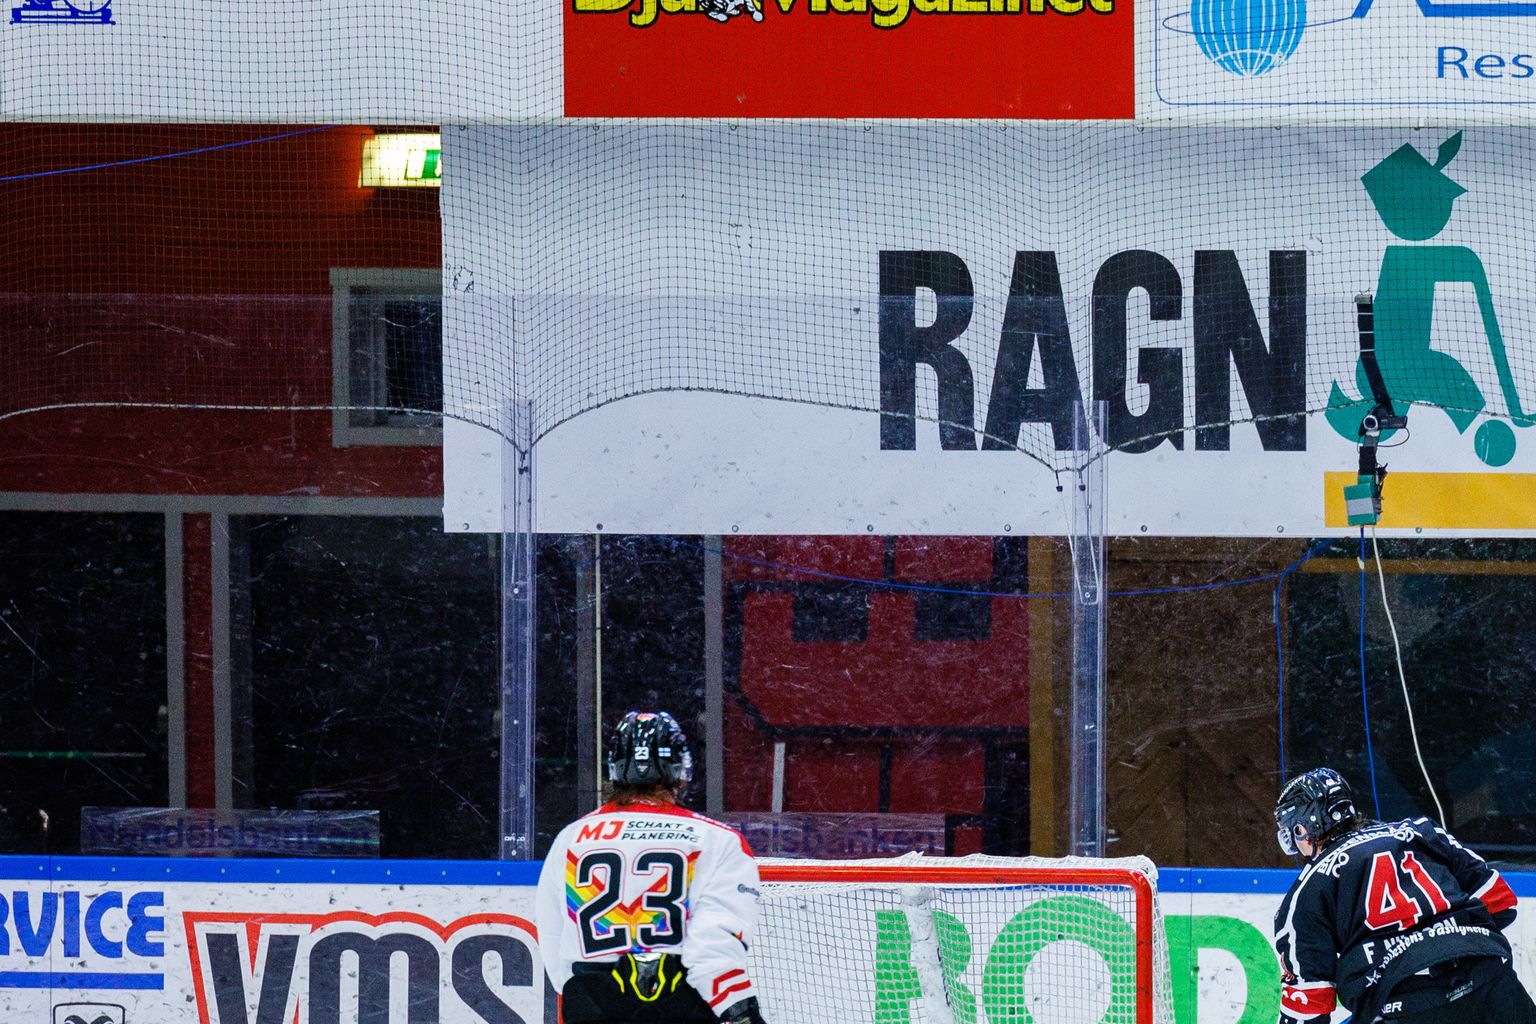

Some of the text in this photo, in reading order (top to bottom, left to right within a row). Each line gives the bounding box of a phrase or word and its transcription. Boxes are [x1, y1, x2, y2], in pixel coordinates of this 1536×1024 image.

[879, 250, 1307, 453] RAGN
[634, 746, 649, 760] 23
[576, 821, 625, 843] MJ
[627, 821, 683, 829] SCHAKT
[621, 832, 699, 843] PLANERING
[577, 851, 686, 956] 23
[1364, 850, 1450, 931] 41
[0, 891, 164, 958] VICE
